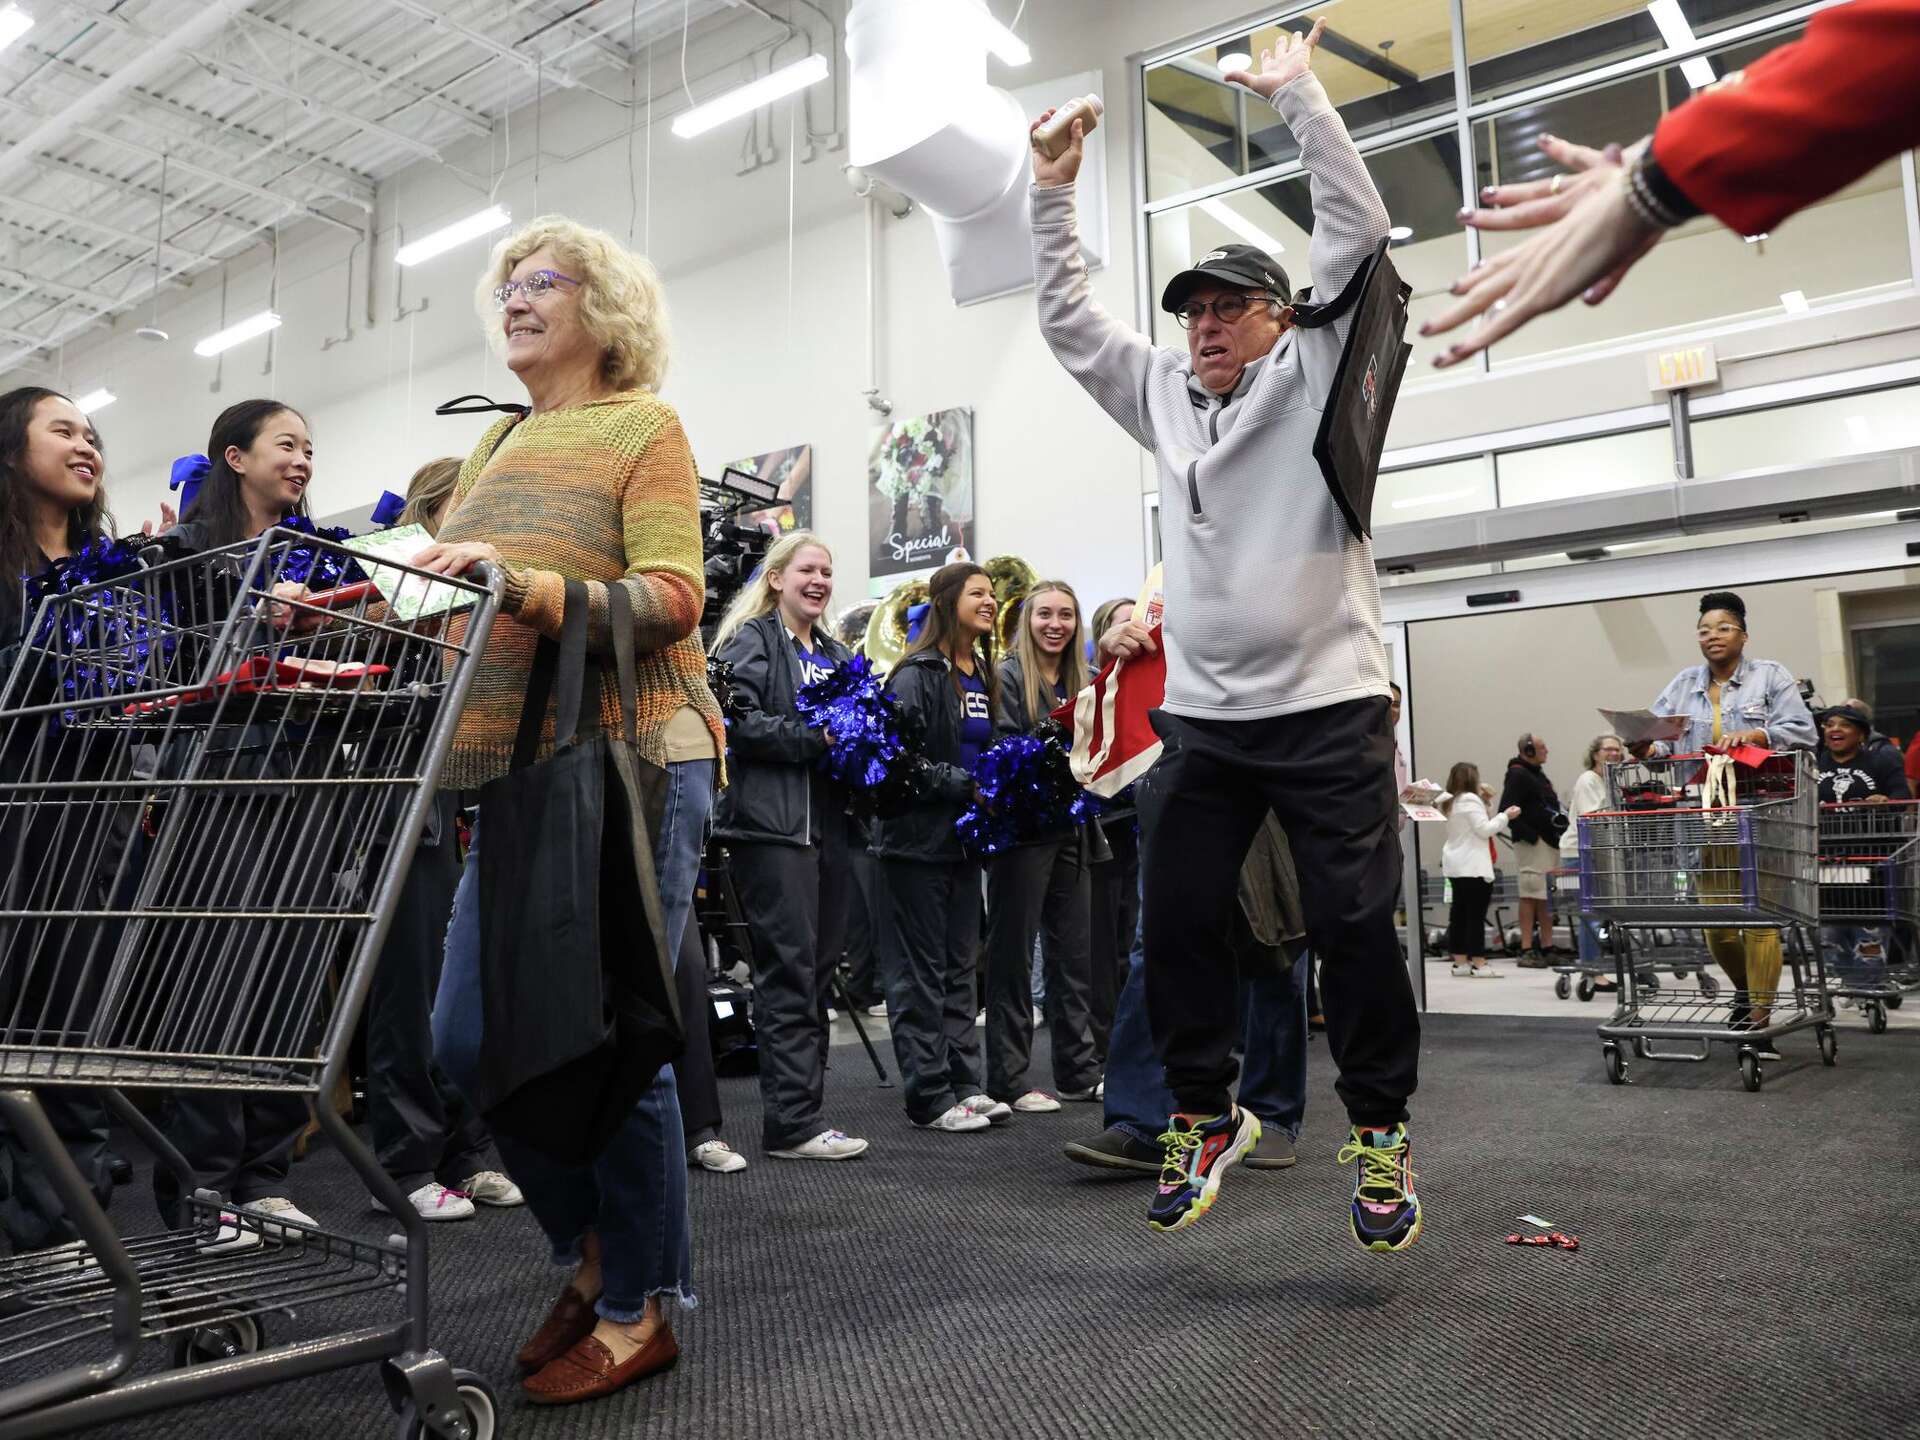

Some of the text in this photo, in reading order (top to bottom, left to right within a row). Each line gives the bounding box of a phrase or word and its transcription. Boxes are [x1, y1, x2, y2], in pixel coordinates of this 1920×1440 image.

[1659, 348, 1706, 385] EXIT
[889, 525, 951, 563] Special
[960, 691, 990, 719] ES
